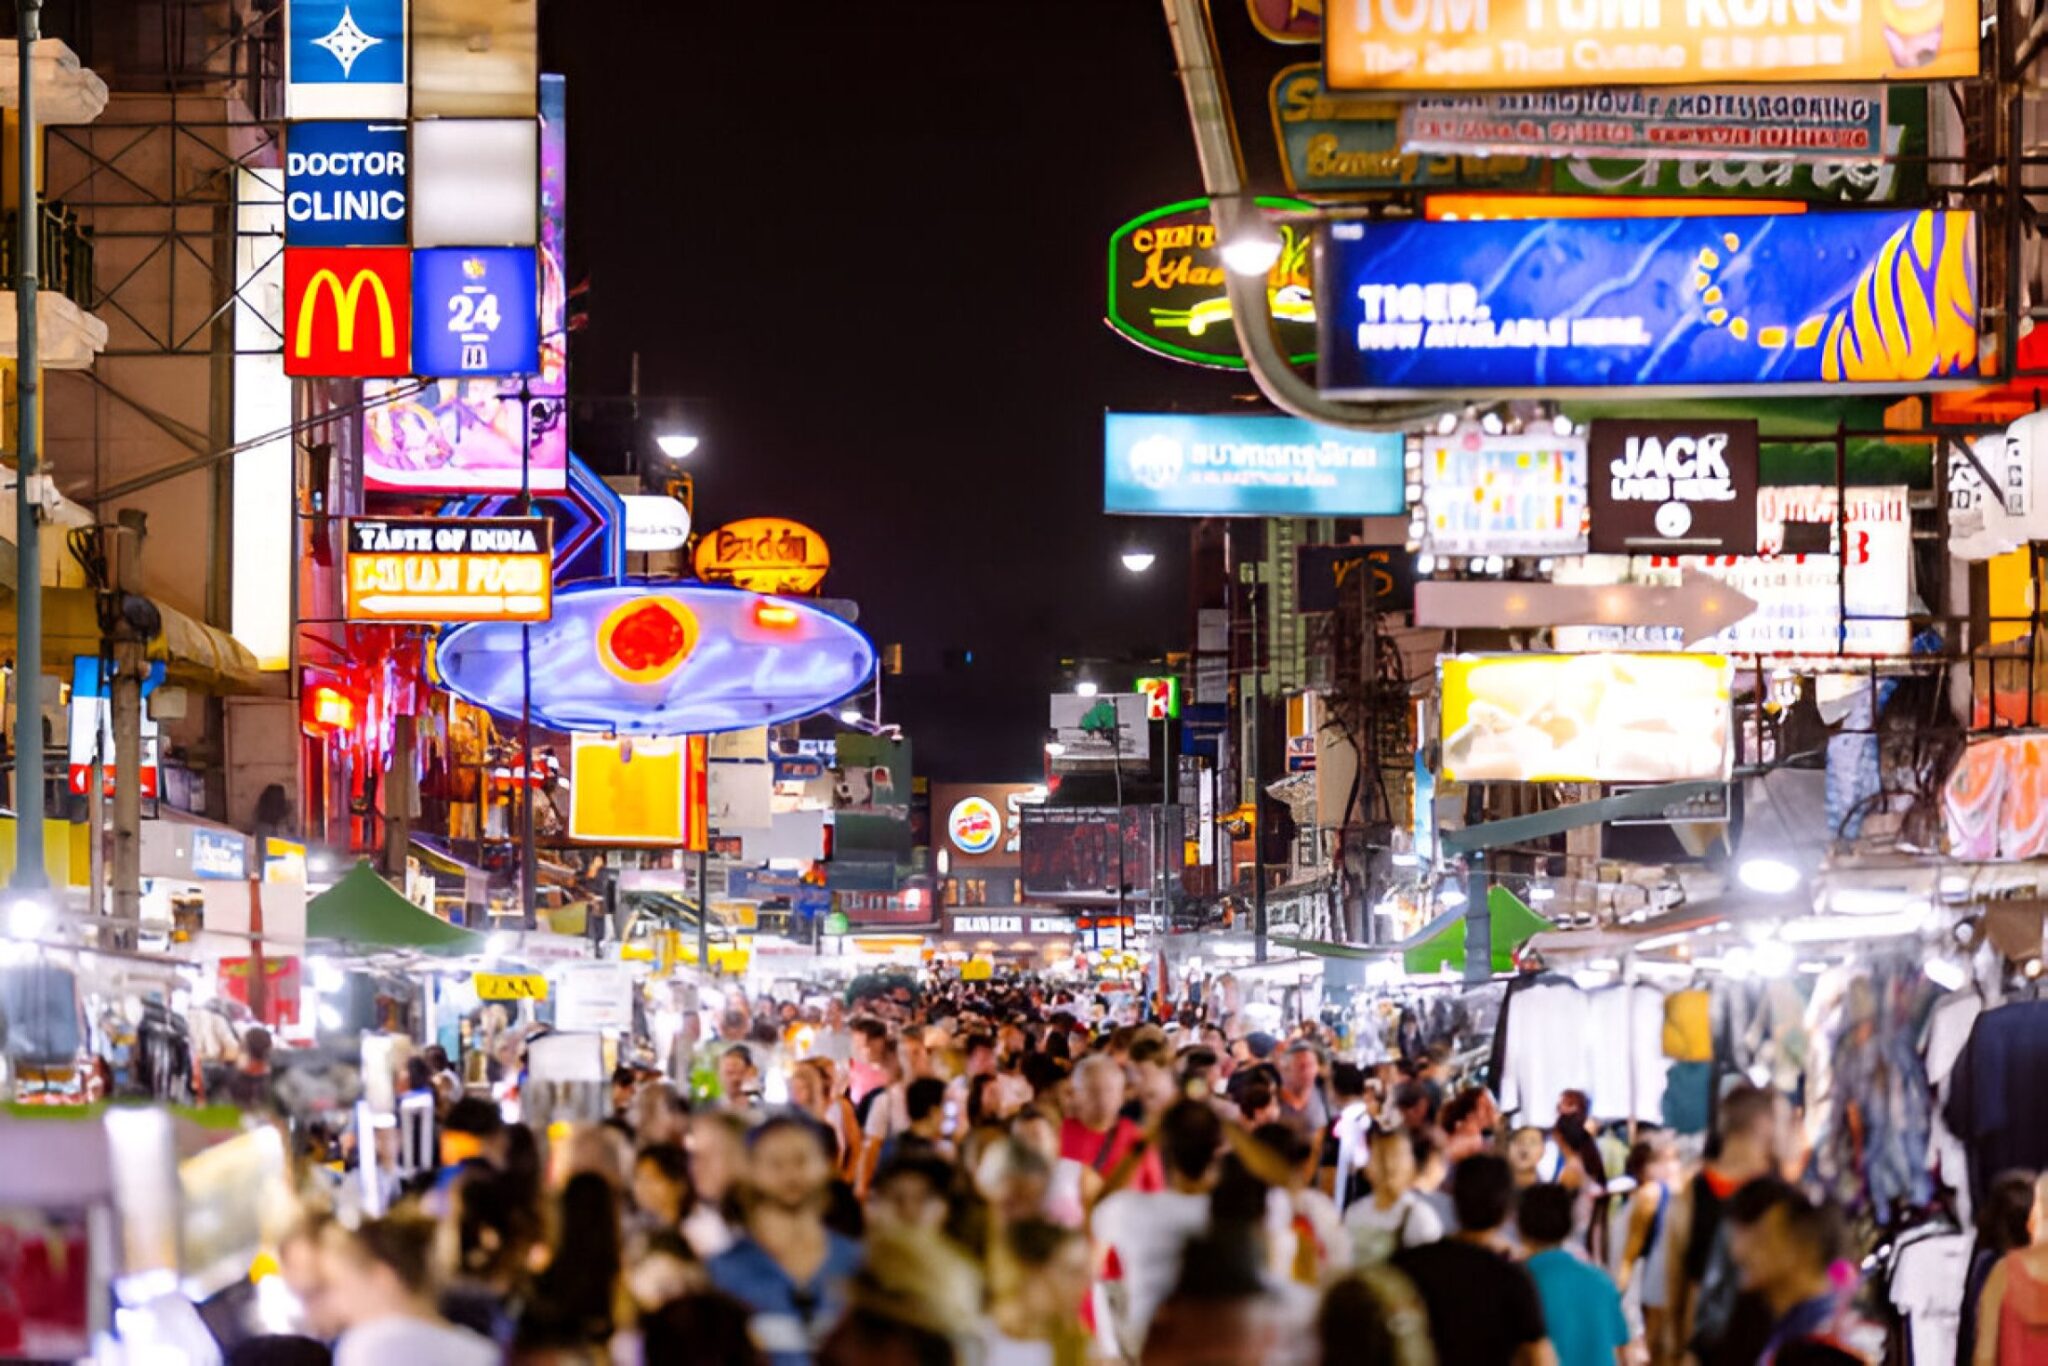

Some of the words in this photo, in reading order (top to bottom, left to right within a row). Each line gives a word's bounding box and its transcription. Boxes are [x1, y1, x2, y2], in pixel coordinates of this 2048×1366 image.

[287, 151, 405, 176] DOCTOR
[287, 190, 405, 221] CLINIC
[448, 294, 501, 332] 24
[1610, 433, 1730, 478] JACK
[435, 528, 467, 552] OF
[470, 528, 538, 552] INDIA
